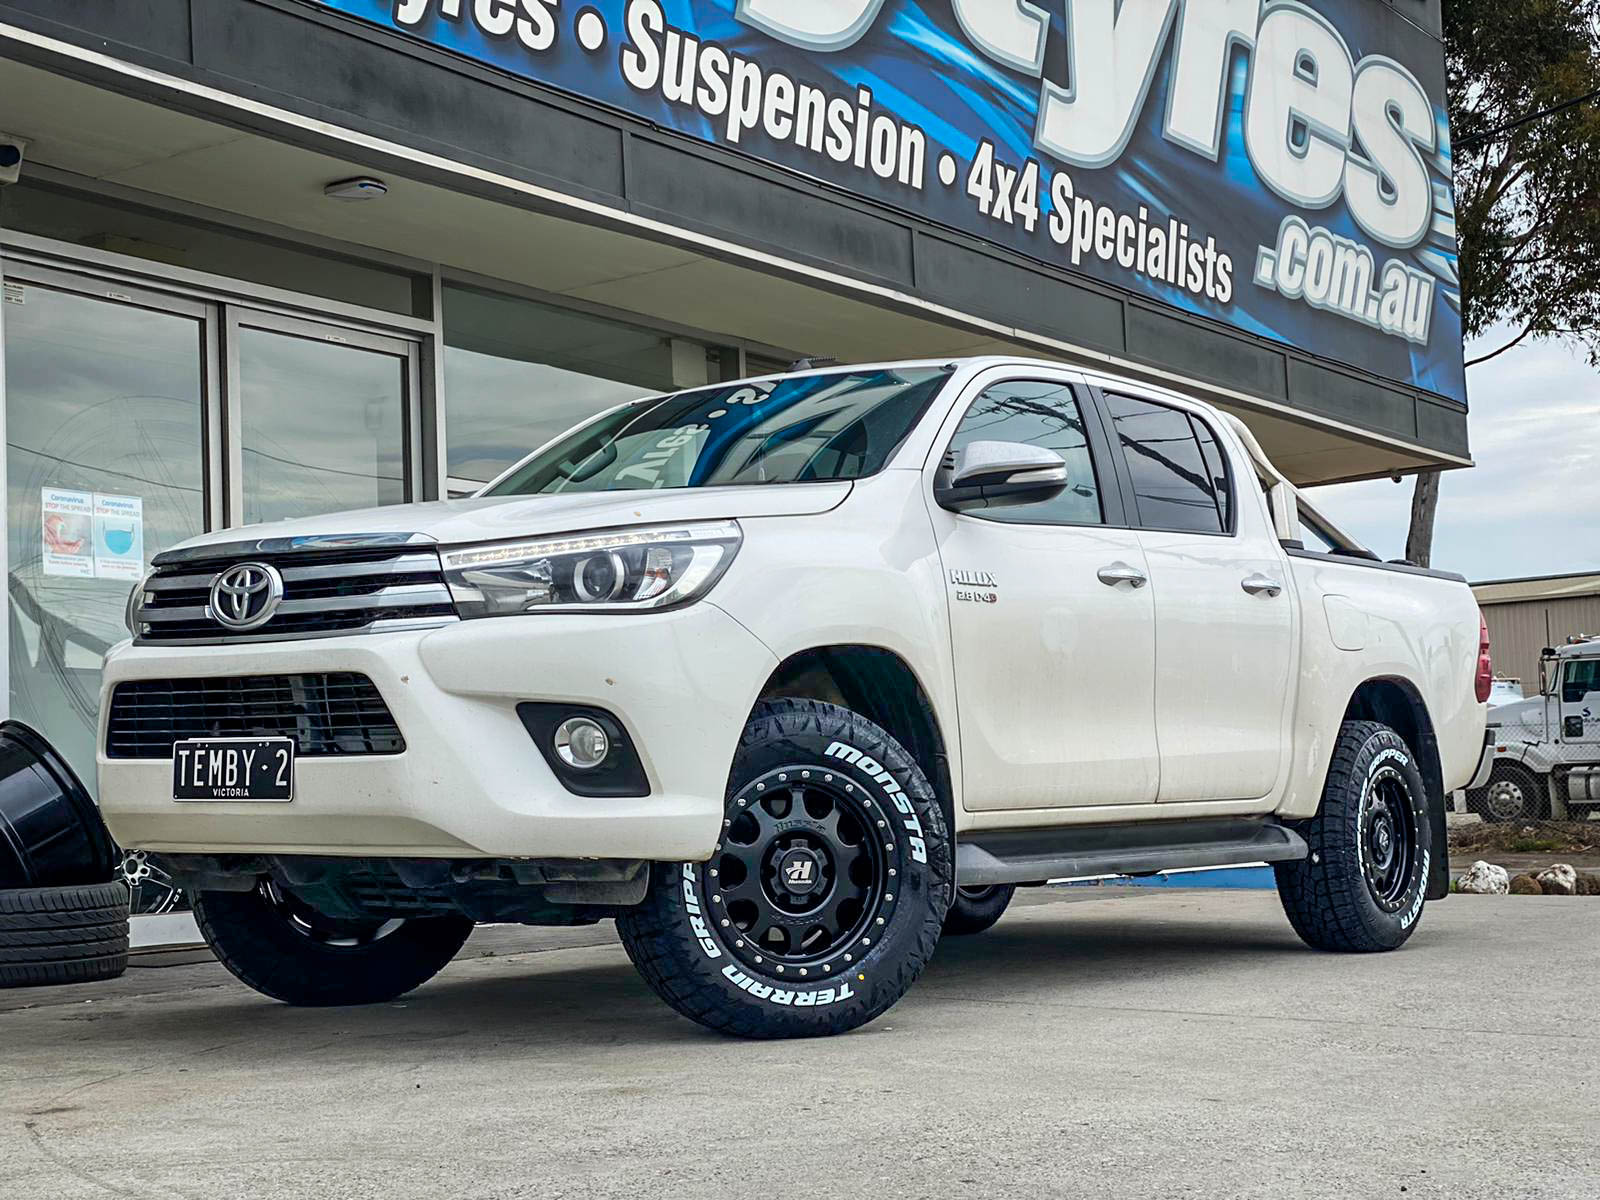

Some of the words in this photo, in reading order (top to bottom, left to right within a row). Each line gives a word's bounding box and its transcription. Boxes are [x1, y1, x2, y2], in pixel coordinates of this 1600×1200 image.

[622, 0, 924, 188] Suspension
[968, 142, 1039, 232] 4x4
[1050, 172, 1233, 302] Specialists
[1256, 217, 1436, 344] .com.au
[949, 569, 997, 588] HILUX
[178, 749, 256, 786] TEMBY
[275, 749, 288, 786] 2
[212, 788, 250, 797] VICTORIA
[824, 741, 927, 864] MONSTA
[721, 964, 855, 1007] TERRAIN
